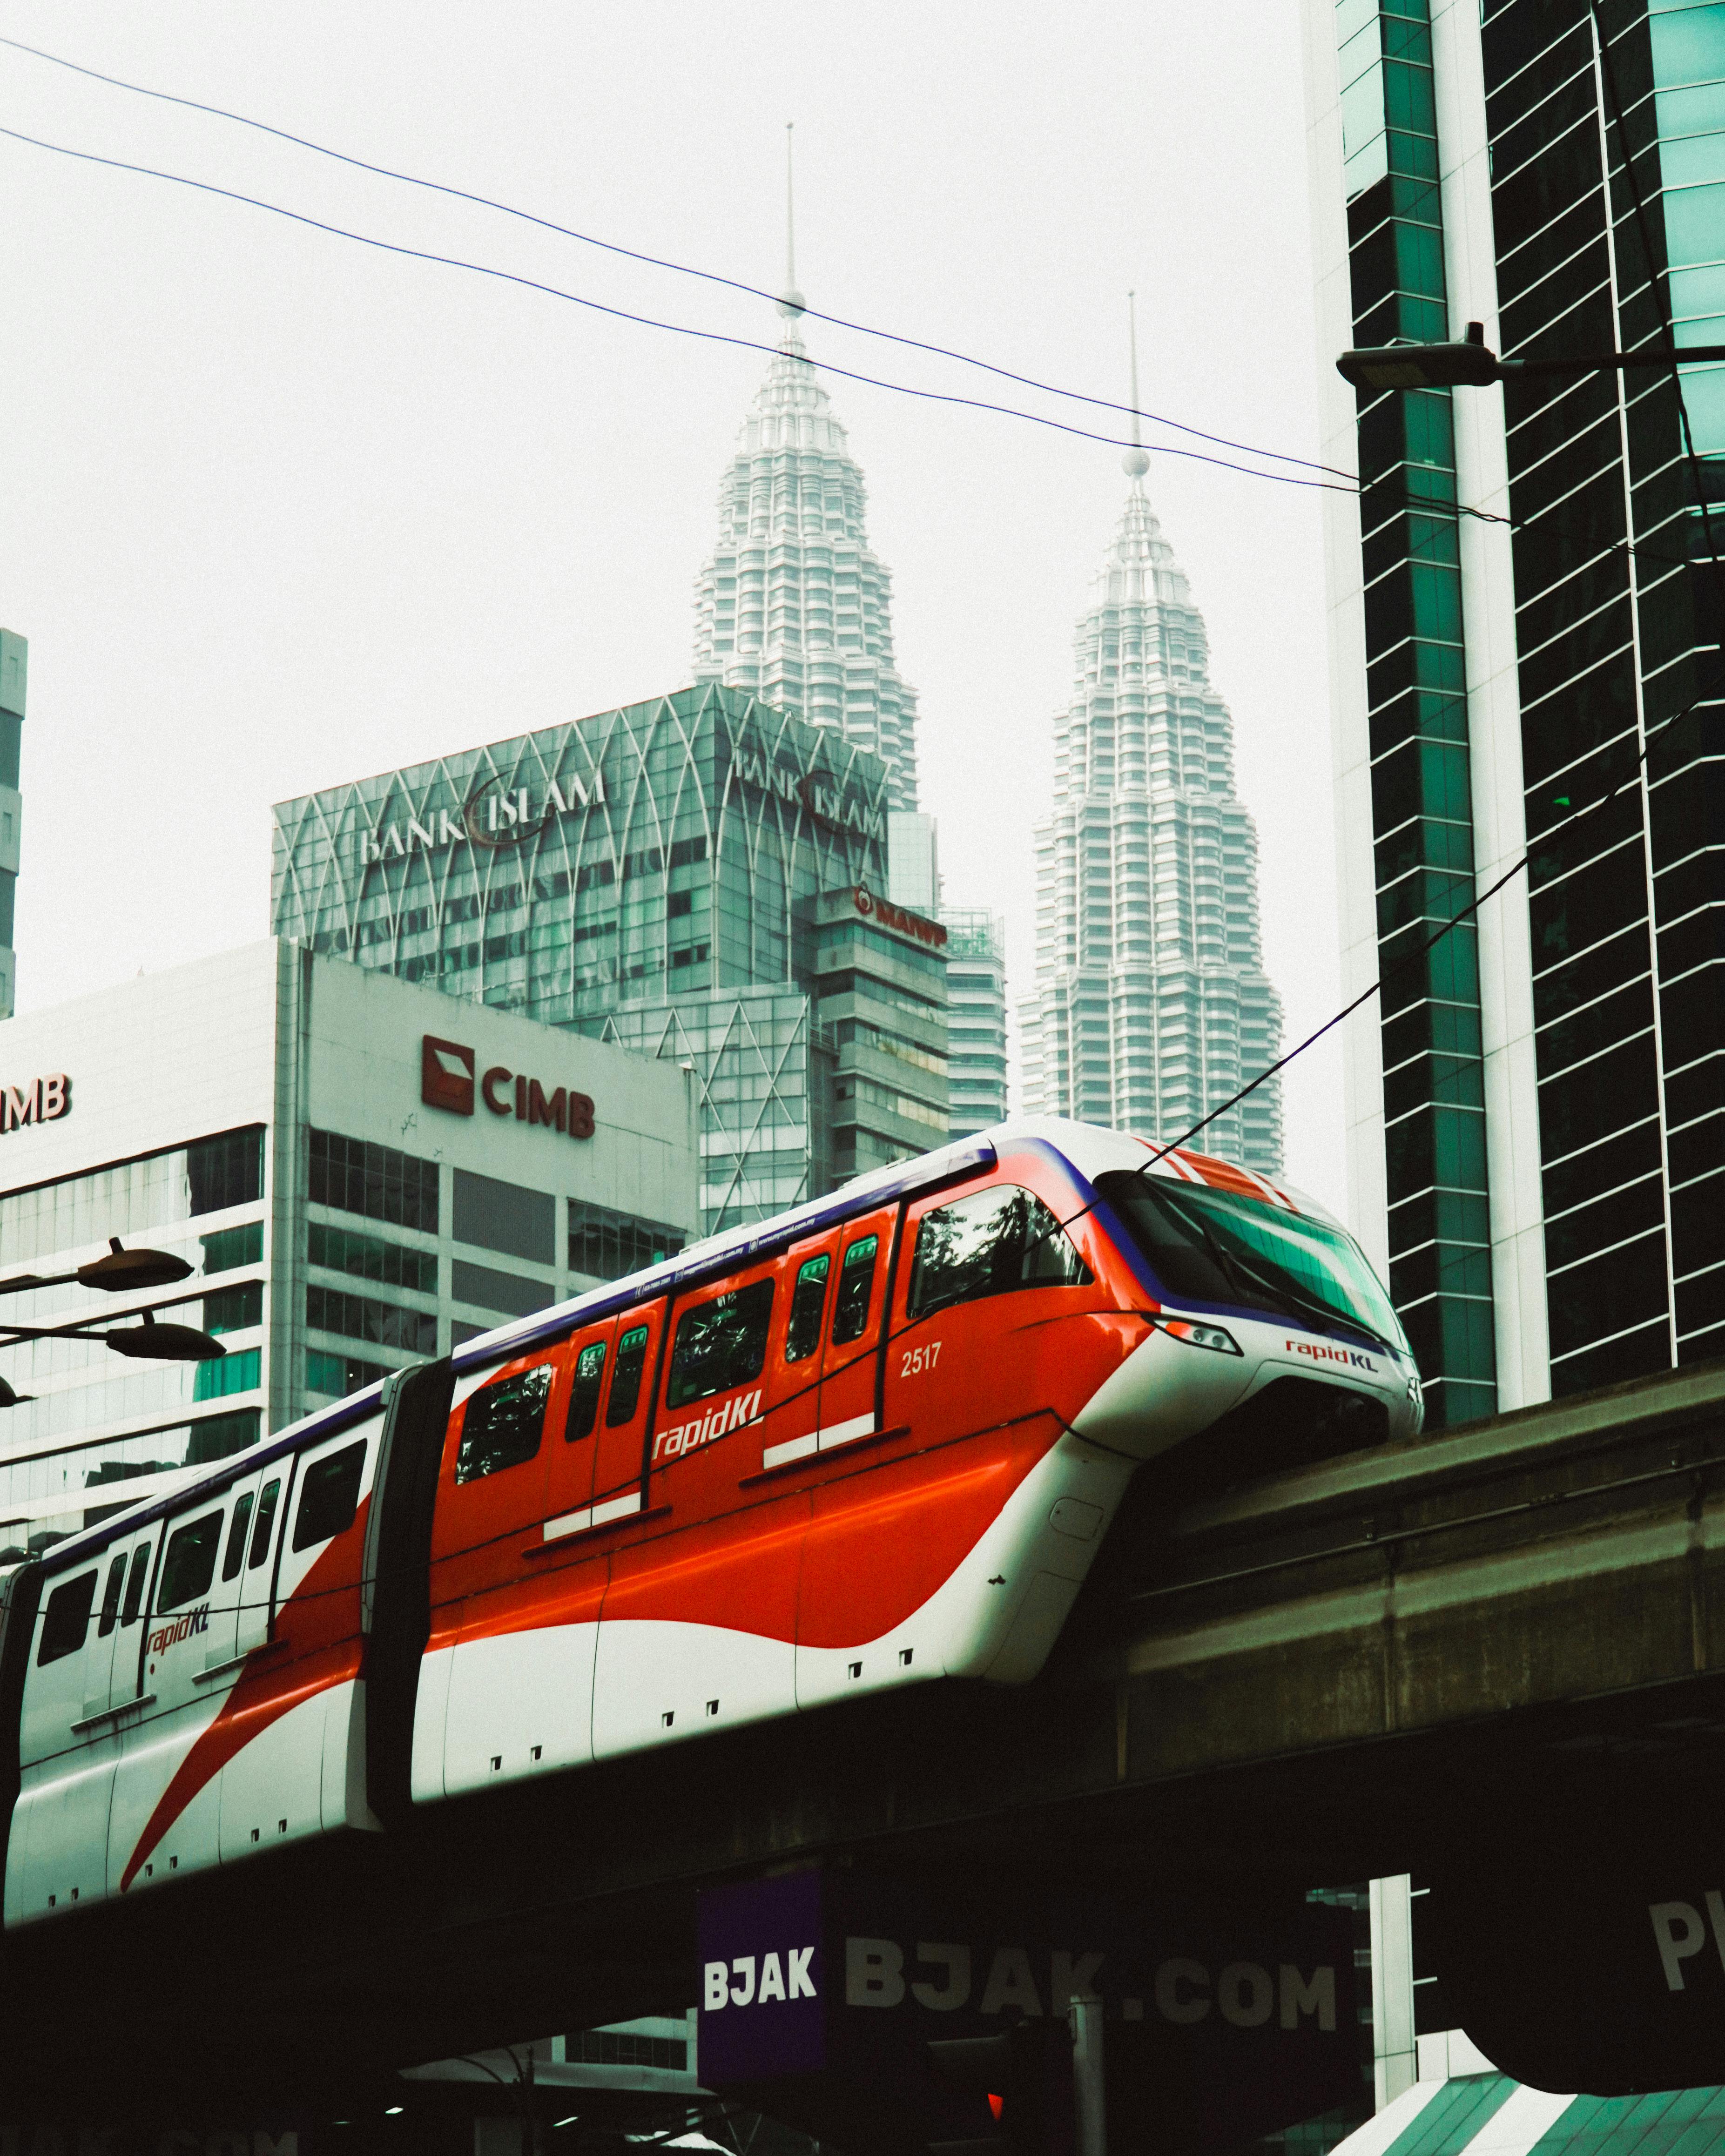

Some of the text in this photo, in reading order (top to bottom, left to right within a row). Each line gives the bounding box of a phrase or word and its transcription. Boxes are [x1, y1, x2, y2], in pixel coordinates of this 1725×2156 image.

[361, 769, 605, 865] BANK ISLAM
[735, 747, 885, 842] BANK ISLAM
[482, 1067, 595, 1139] CIMB
[901, 1341, 942, 1378] 2517
[1286, 1340, 1379, 1373] rapidKL
[652, 1389, 764, 1460] rapidKL
[145, 1602, 209, 1656] rapidKL
[705, 1947, 817, 2011] BJAK
[846, 1936, 1336, 2032] BJAK.COM
